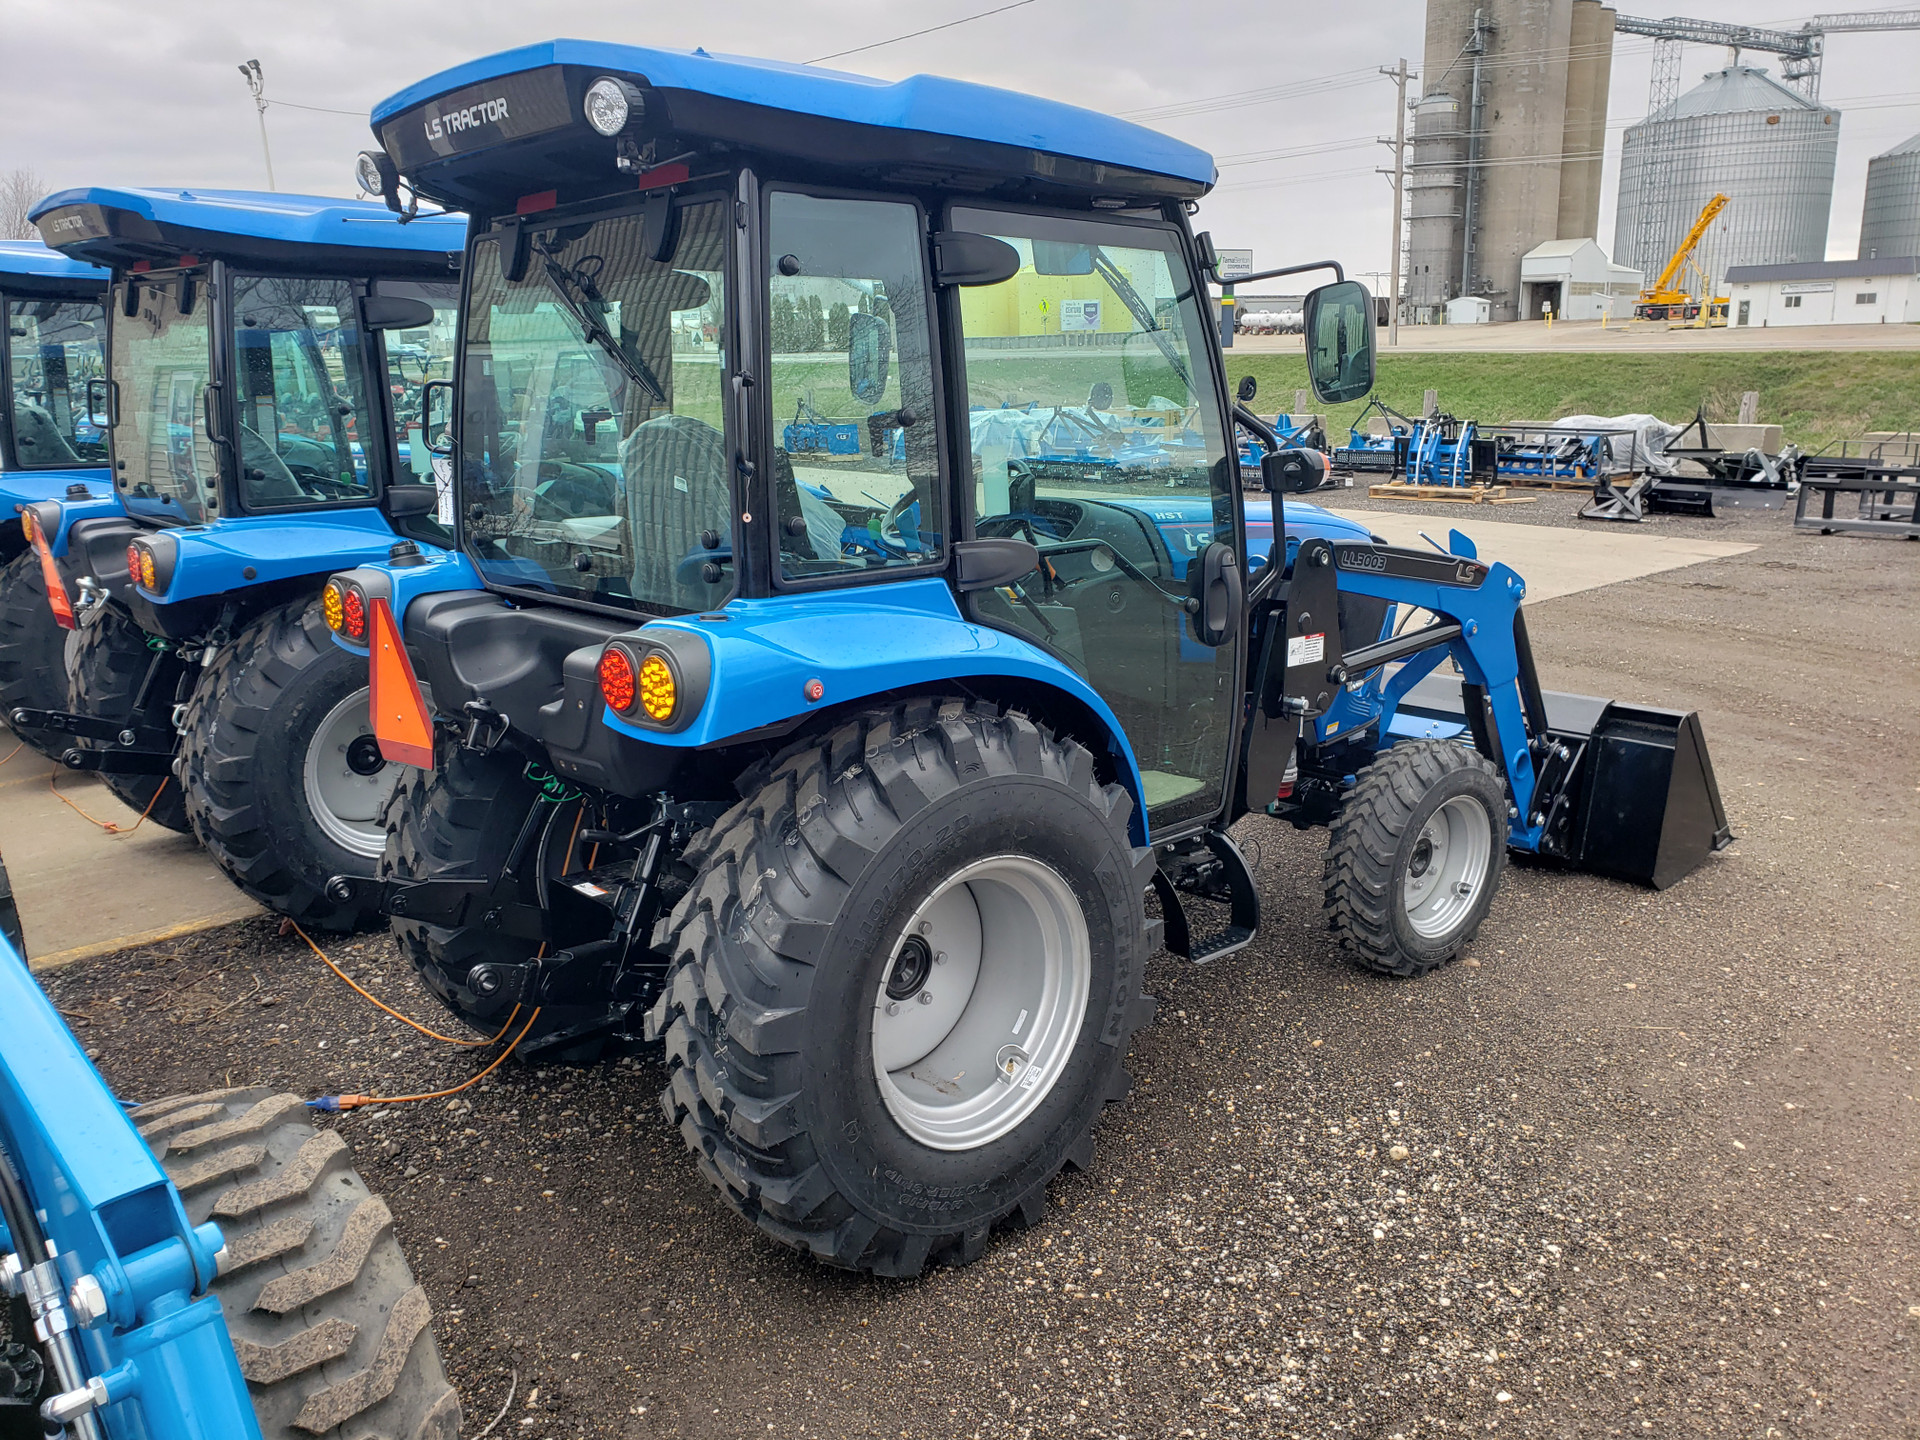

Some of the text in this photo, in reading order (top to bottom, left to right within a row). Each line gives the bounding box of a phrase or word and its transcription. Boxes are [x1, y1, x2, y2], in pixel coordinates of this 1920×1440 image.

[424, 97, 510, 141] LS TRACTOR
[51, 215, 84, 232] LS TRACTOR
[1155, 512, 1183, 520] HST
[1341, 550, 1477, 583] LL3003 LS
